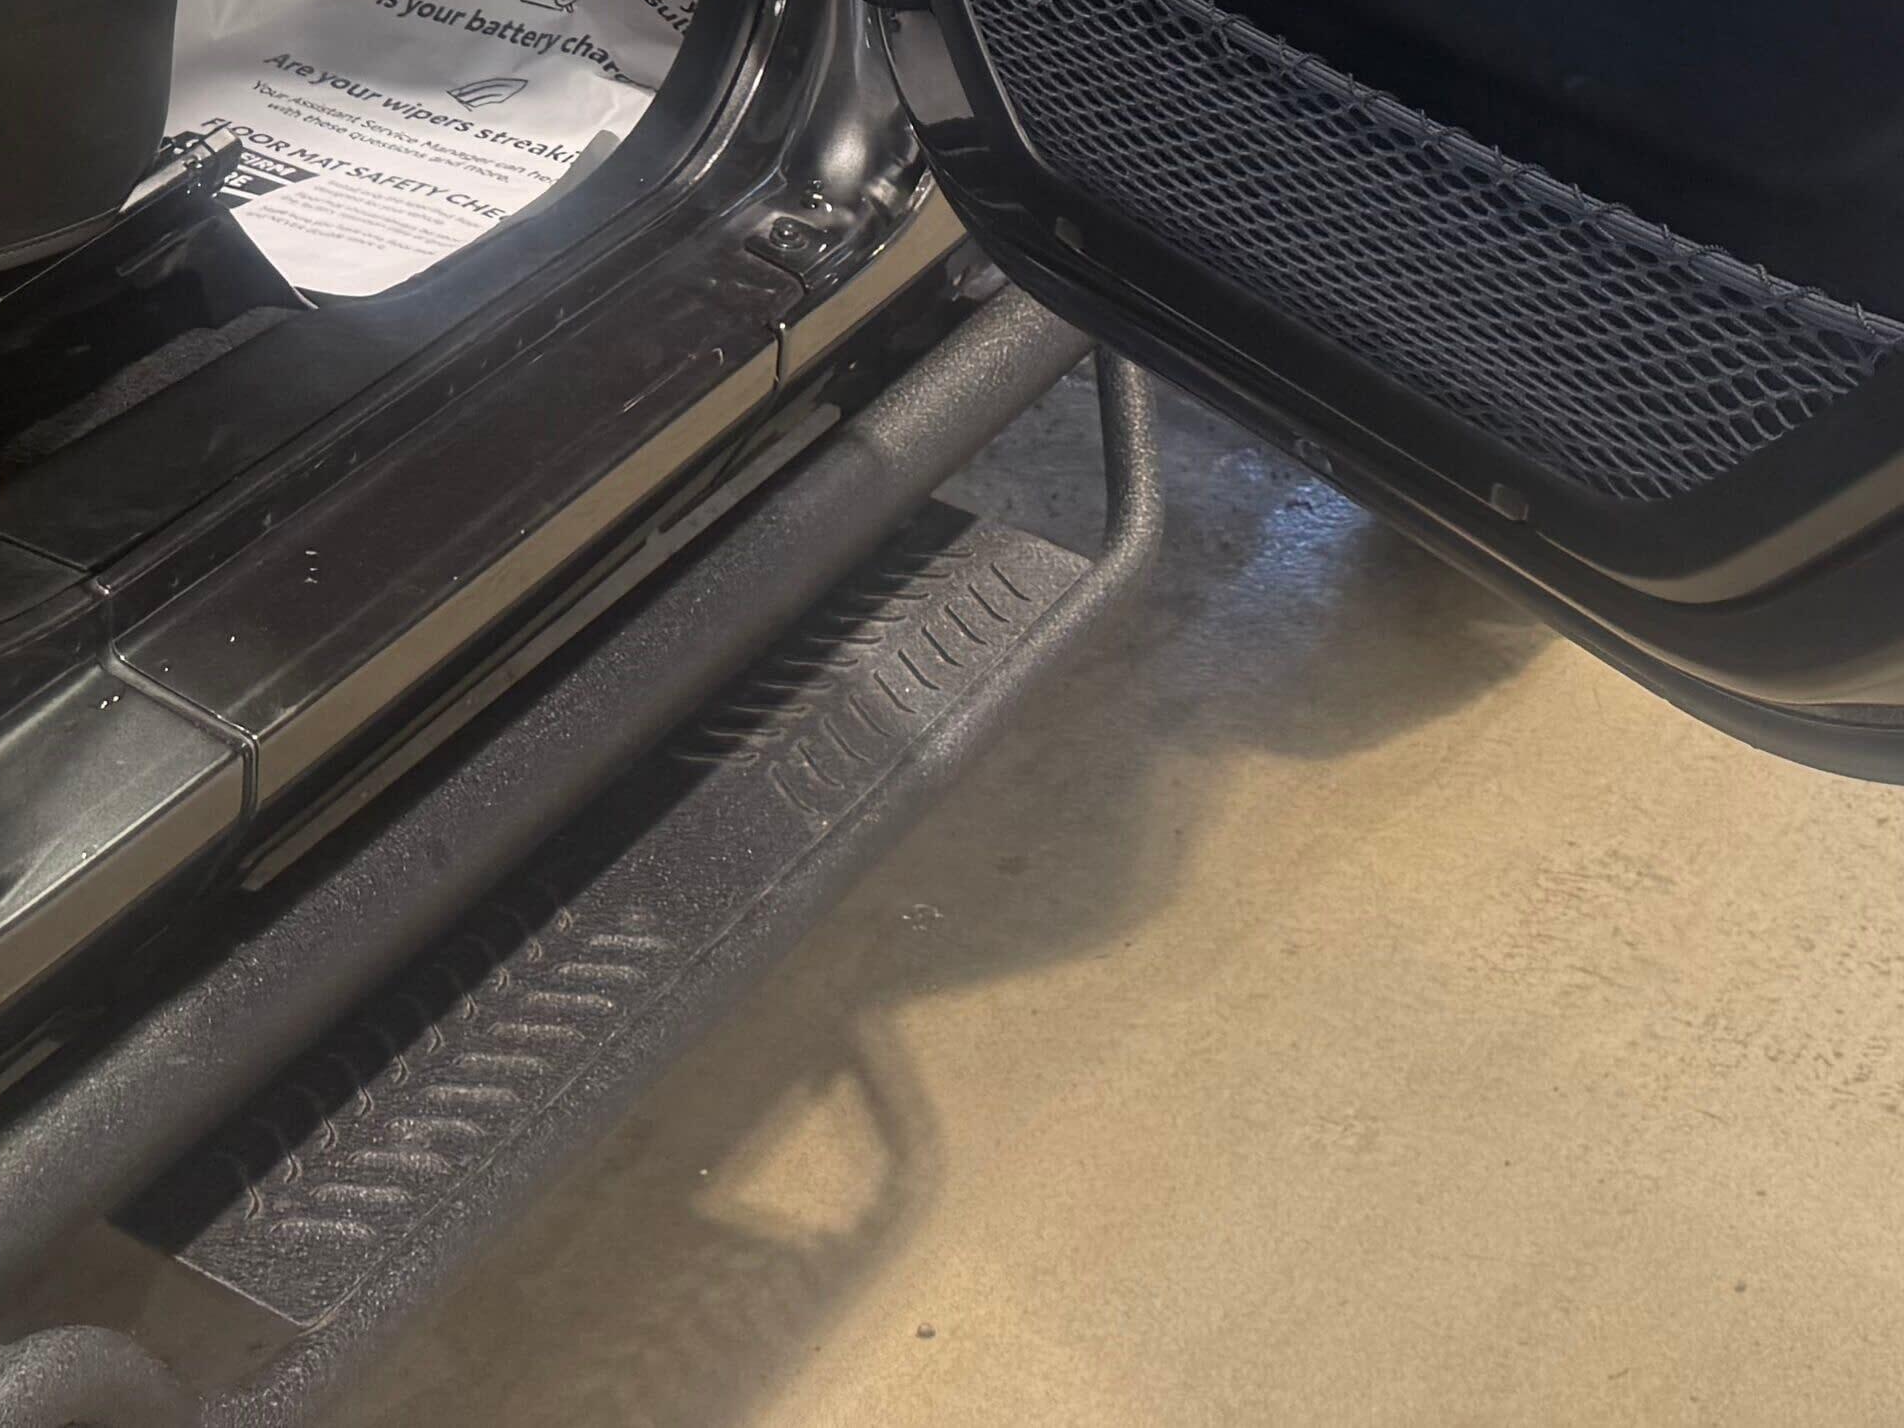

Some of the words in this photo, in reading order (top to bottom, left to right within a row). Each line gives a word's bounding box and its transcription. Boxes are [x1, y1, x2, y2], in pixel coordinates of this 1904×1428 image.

[464, 8, 562, 55] battery
[262, 52, 316, 77] Are
[307, 70, 383, 102] your
[381, 97, 475, 134] wipers
[266, 100, 304, 120] with
[302, 113, 349, 136] these
[348, 129, 429, 161] questions
[288, 96, 362, 124] Assistant
[359, 117, 420, 144] Service
[425, 139, 495, 167] Manager
[495, 160, 528, 175] can
[287, 147, 352, 173] MAT
[345, 159, 449, 197] SAFETY
